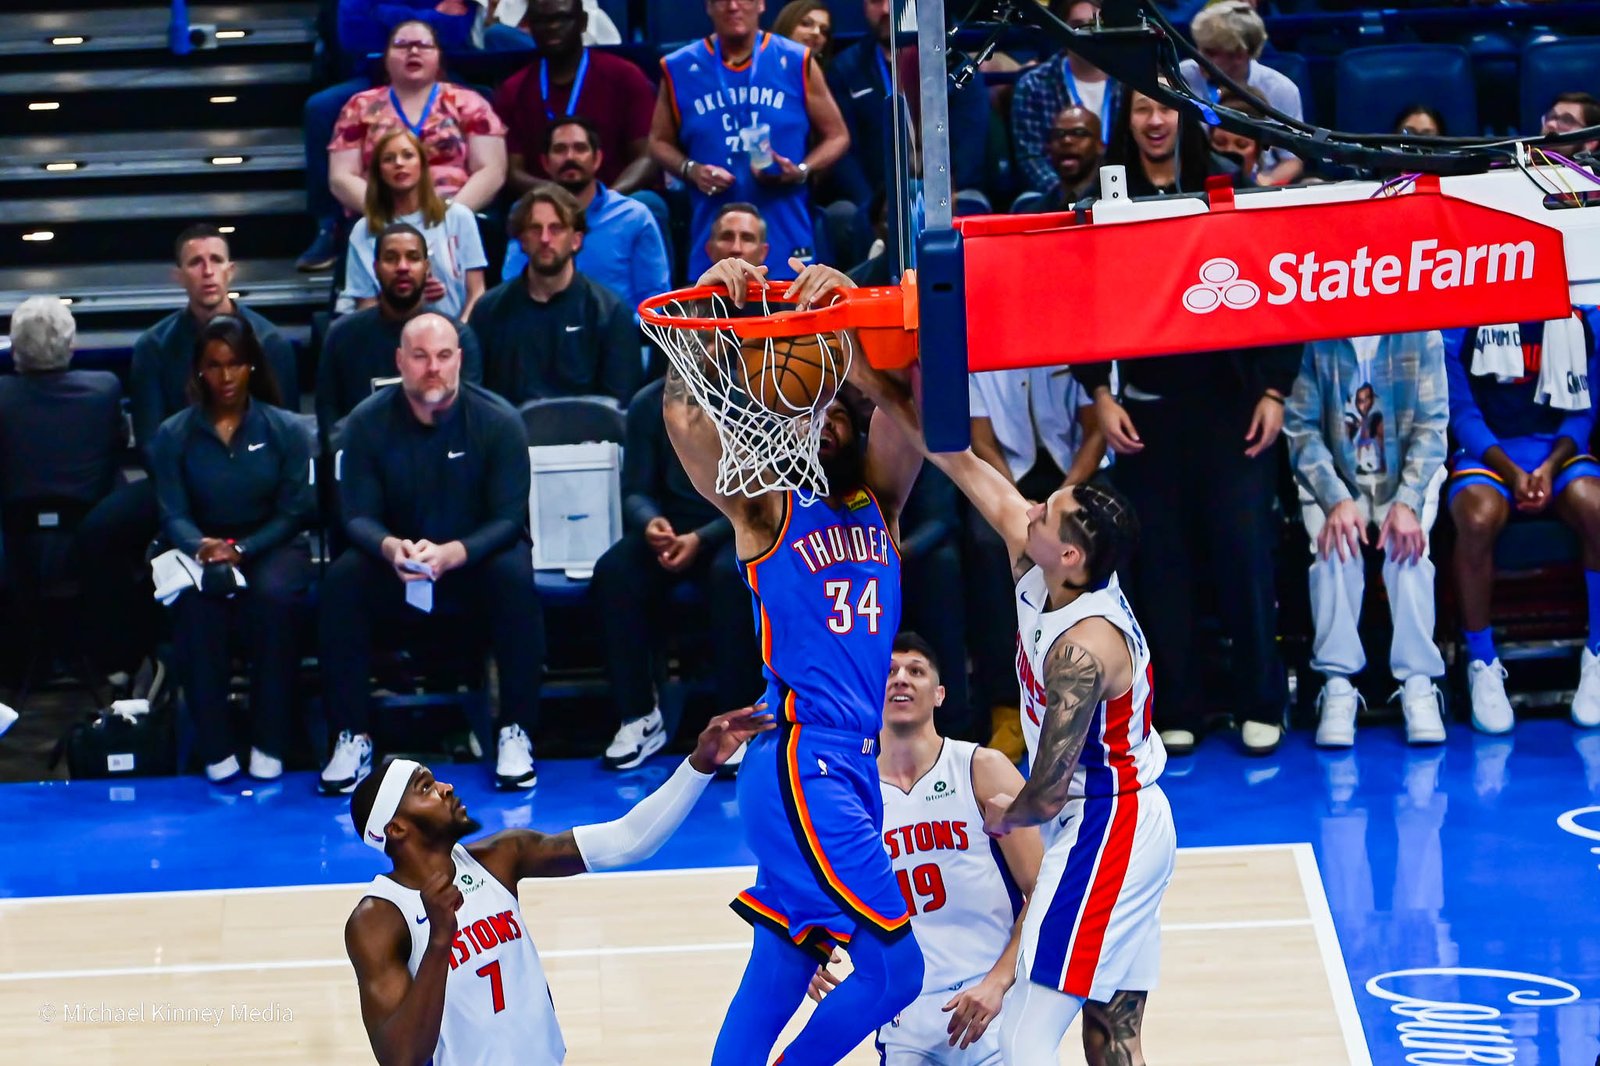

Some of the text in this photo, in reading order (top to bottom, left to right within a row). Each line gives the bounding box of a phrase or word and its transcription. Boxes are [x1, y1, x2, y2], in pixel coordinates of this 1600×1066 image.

[792, 525, 889, 574] THUNDER
[824, 577, 883, 634] 34
[884, 820, 969, 860] STONS
[895, 862, 947, 917] 19
[475, 959, 506, 1015] 7
